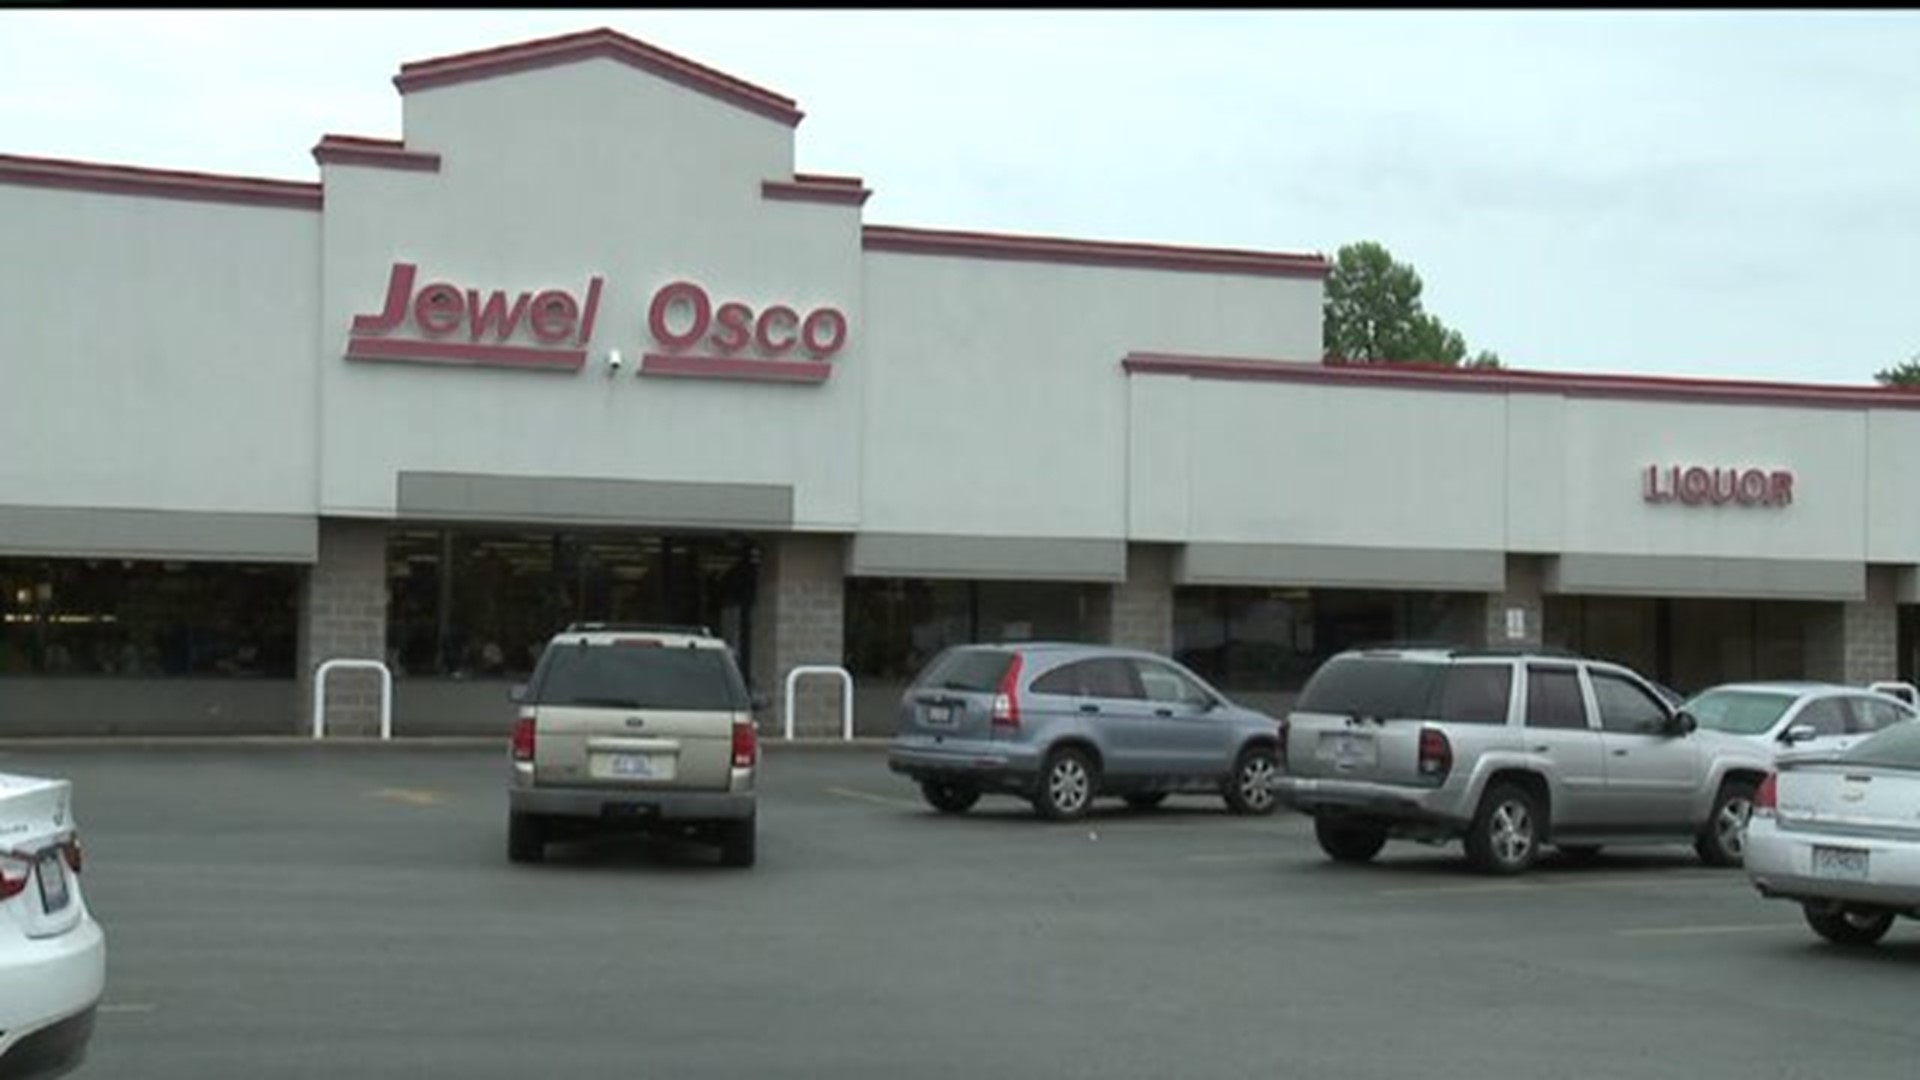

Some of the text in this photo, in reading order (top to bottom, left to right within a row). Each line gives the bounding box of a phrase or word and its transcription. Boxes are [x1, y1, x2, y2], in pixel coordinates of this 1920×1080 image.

[350, 262, 848, 357] Jewel Osco
[1642, 464, 1795, 508] LIQUOR
